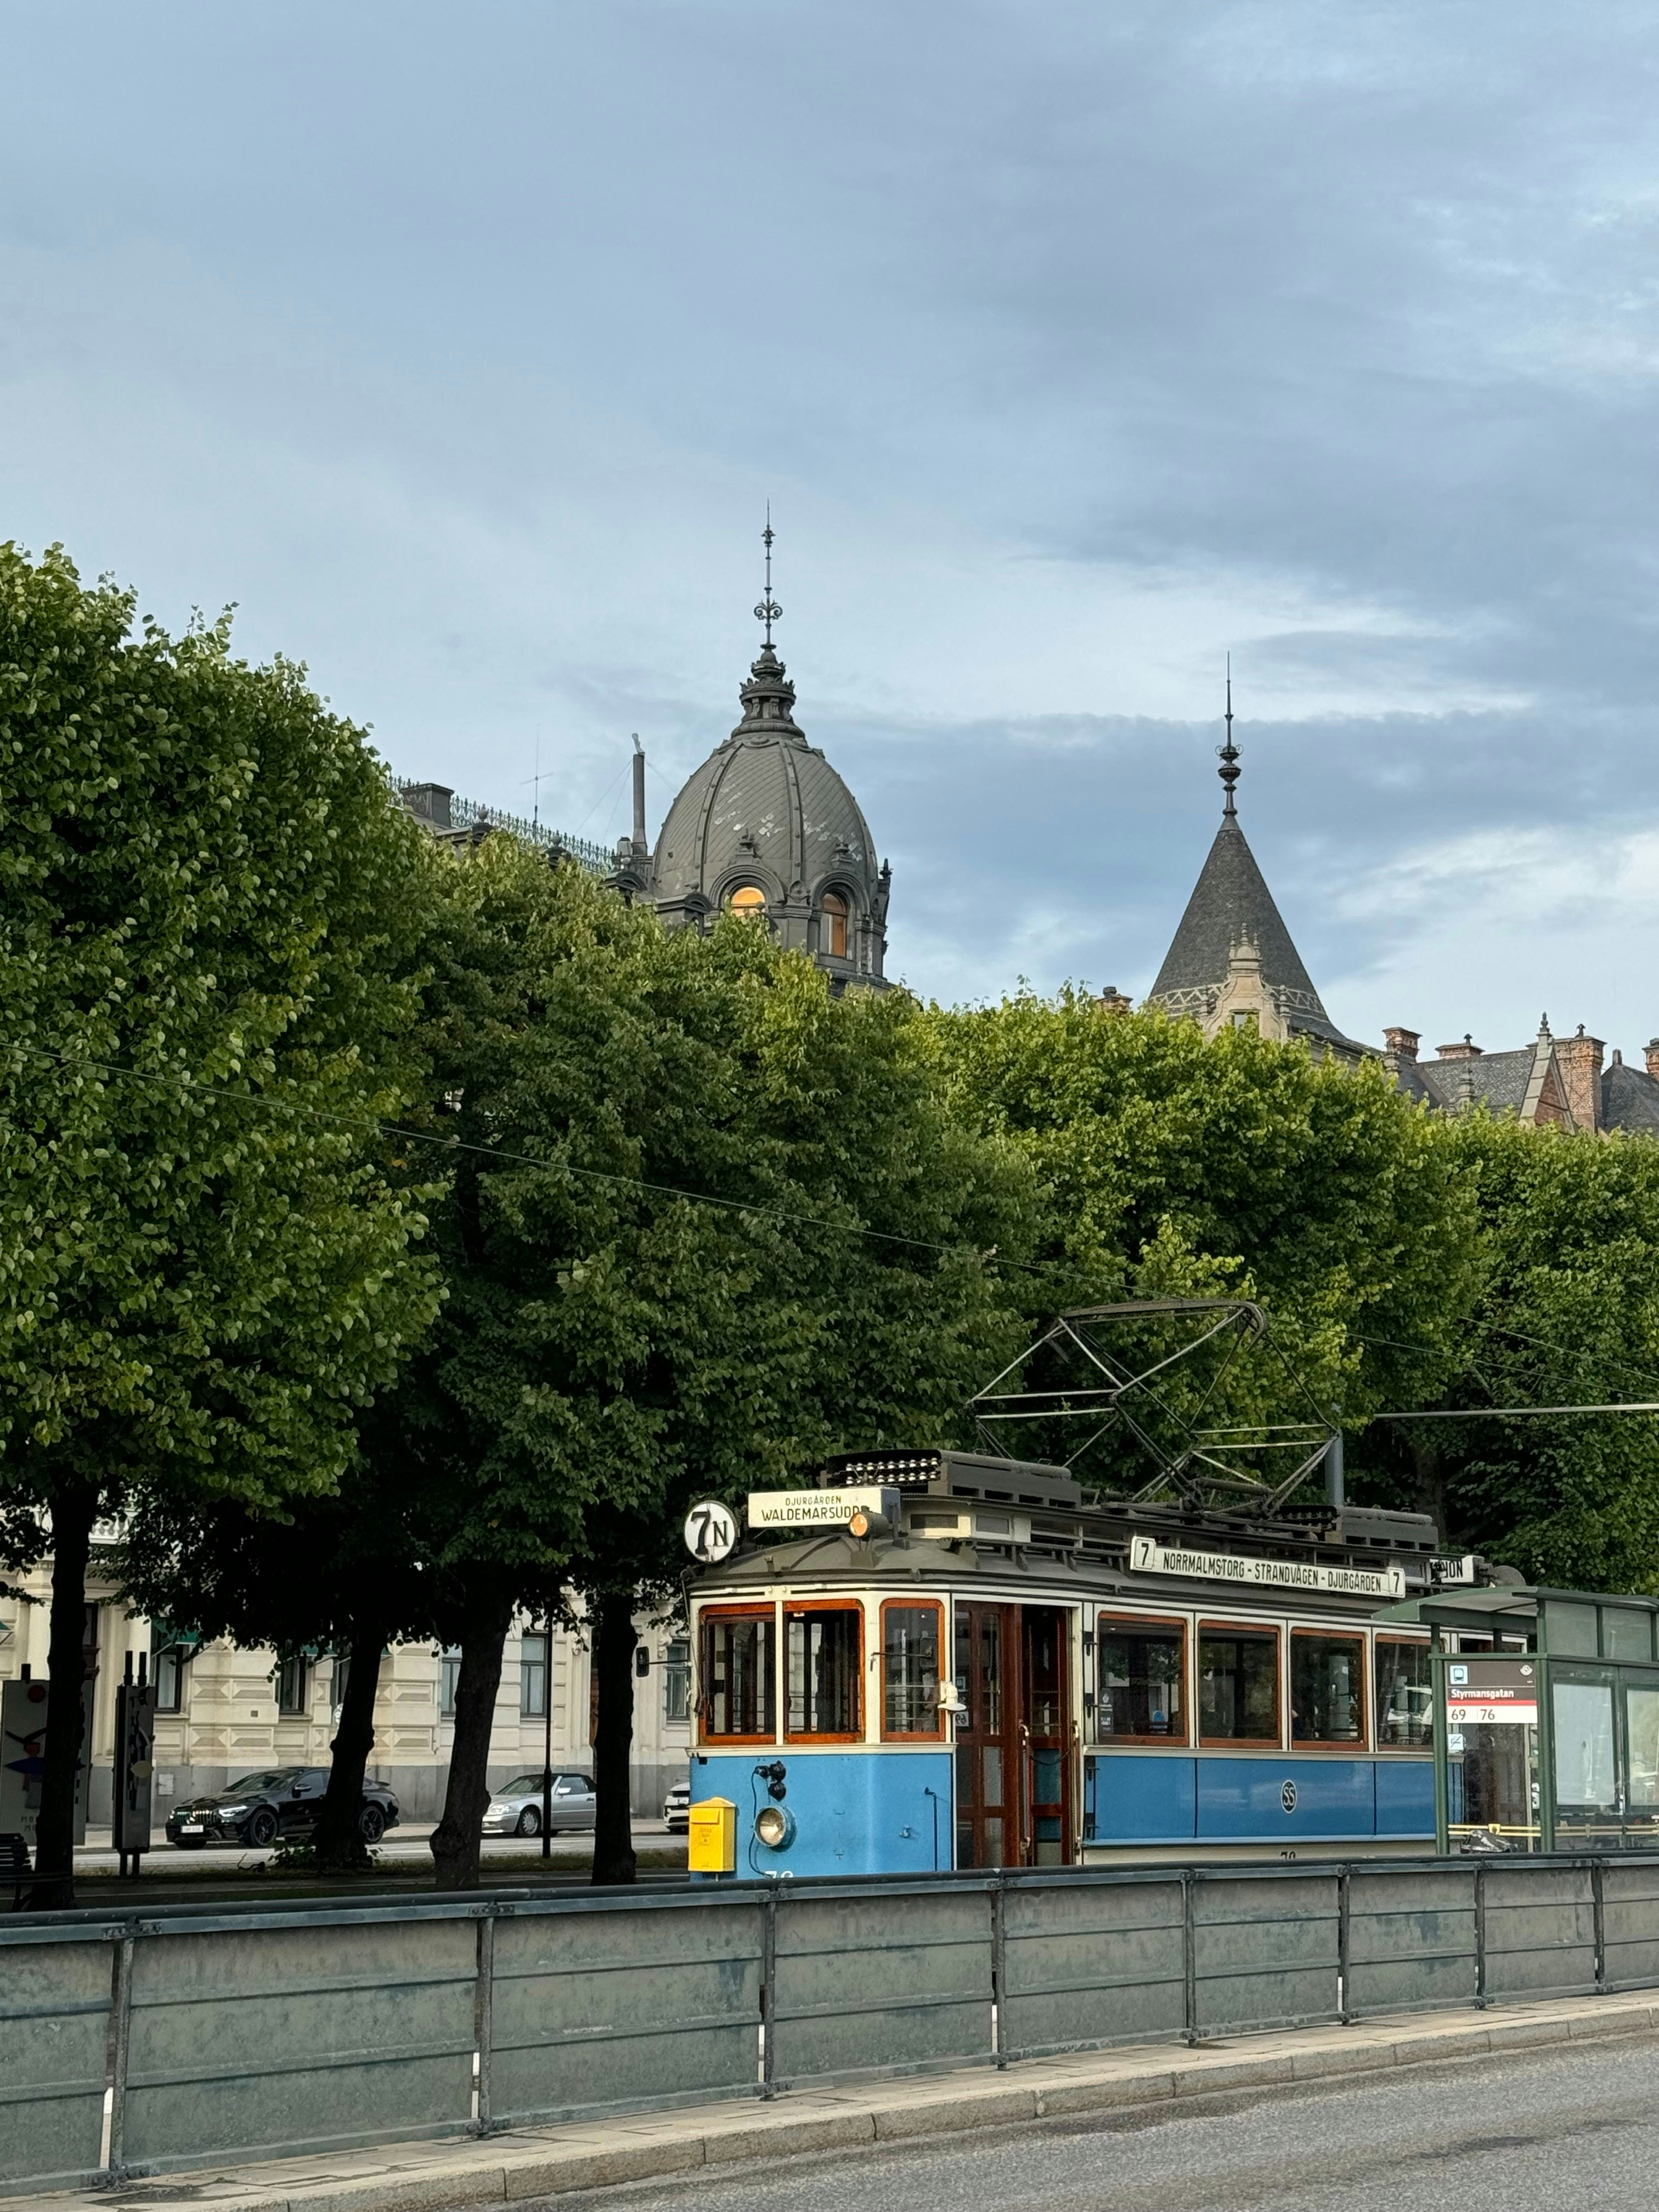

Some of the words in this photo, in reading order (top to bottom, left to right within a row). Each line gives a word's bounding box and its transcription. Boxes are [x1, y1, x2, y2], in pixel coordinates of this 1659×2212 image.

[785, 1495, 842, 1506] DJURGÅRDEN
[761, 1505, 861, 1522] WALDEMARSUDD
[1141, 1537, 1149, 1566] 7
[1163, 1551, 1245, 1578] NORRMALMSTORG
[1328, 1571, 1381, 1593] DJURGÅRDEN
[1392, 1572, 1400, 1593] 7
[1451, 1689, 1515, 1700] Styrmansgatan
[1451, 1709, 1466, 1720] 69
[1480, 1709, 1495, 1720] 76
